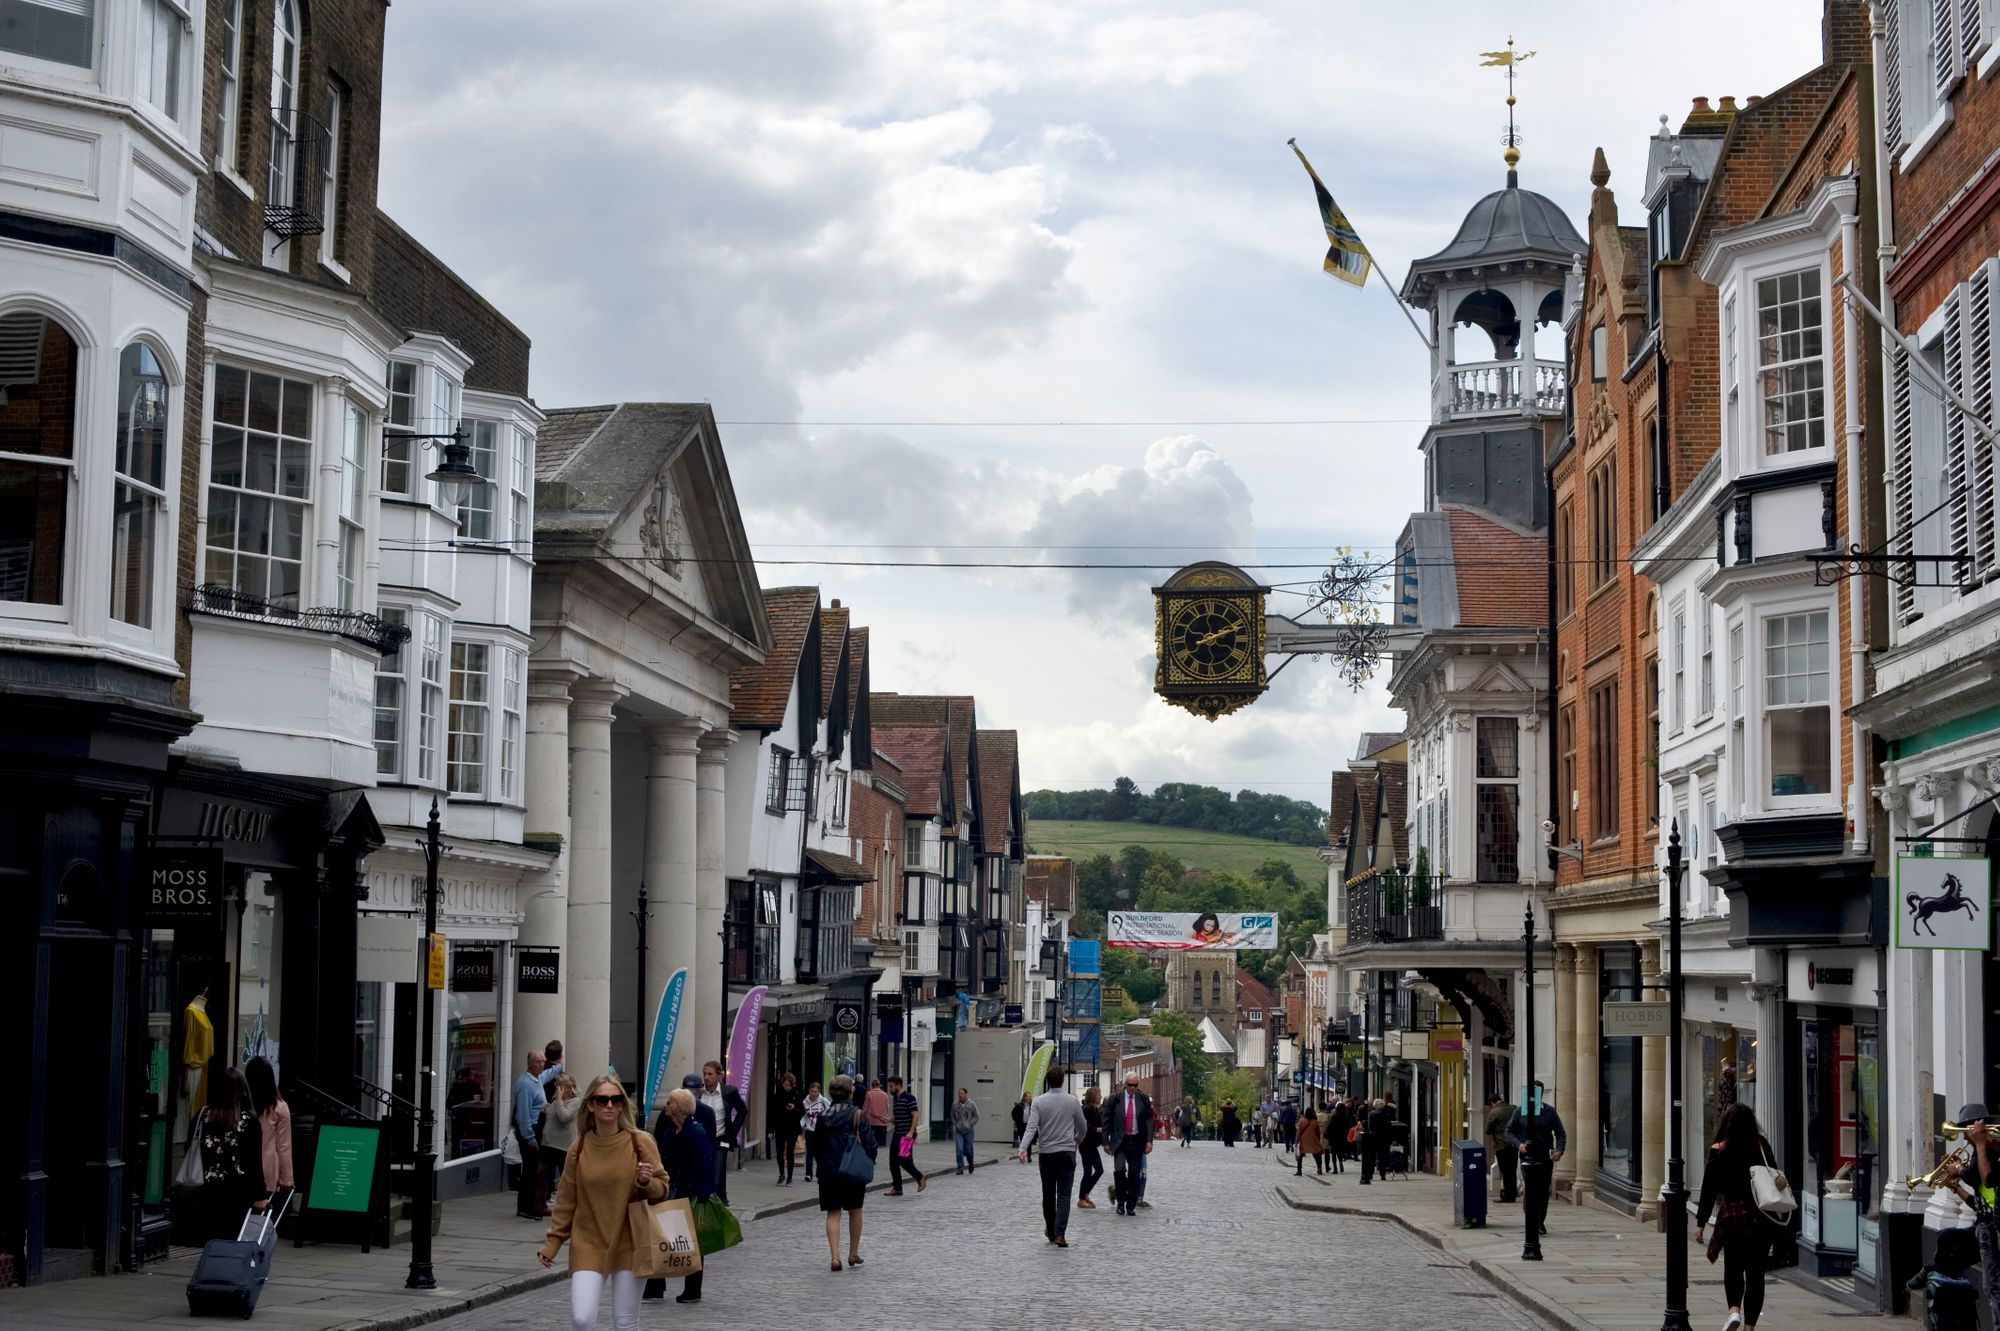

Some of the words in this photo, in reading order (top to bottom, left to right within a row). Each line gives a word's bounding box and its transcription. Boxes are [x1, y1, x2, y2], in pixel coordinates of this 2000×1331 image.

[152, 869, 207, 885] MOSS
[152, 888, 212, 905] BROS.
[522, 966, 556, 976] BOSS
[671, 977, 682, 1013] OPEN
[748, 993, 761, 1025] OPEN
[1615, 1011, 1663, 1022] HOBBS
[666, 1015, 678, 1042] FOR
[746, 1026, 755, 1050] FOR
[659, 1235, 690, 1252] outfit
